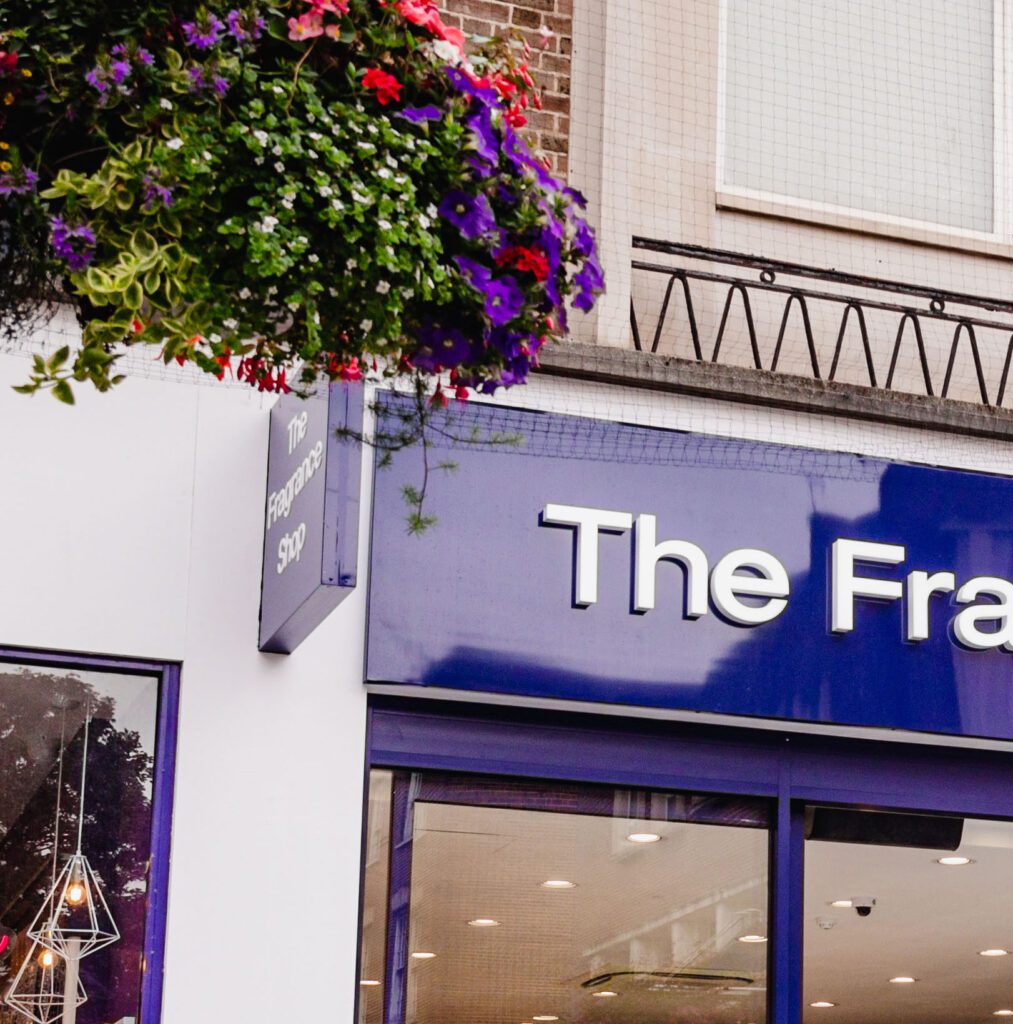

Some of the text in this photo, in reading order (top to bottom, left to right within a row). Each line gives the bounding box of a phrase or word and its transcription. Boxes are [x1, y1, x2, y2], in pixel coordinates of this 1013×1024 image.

[288, 411, 307, 454] The
[267, 441, 323, 529] Fragrance
[277, 523, 306, 575] Shop
[541, 503, 790, 626] The
